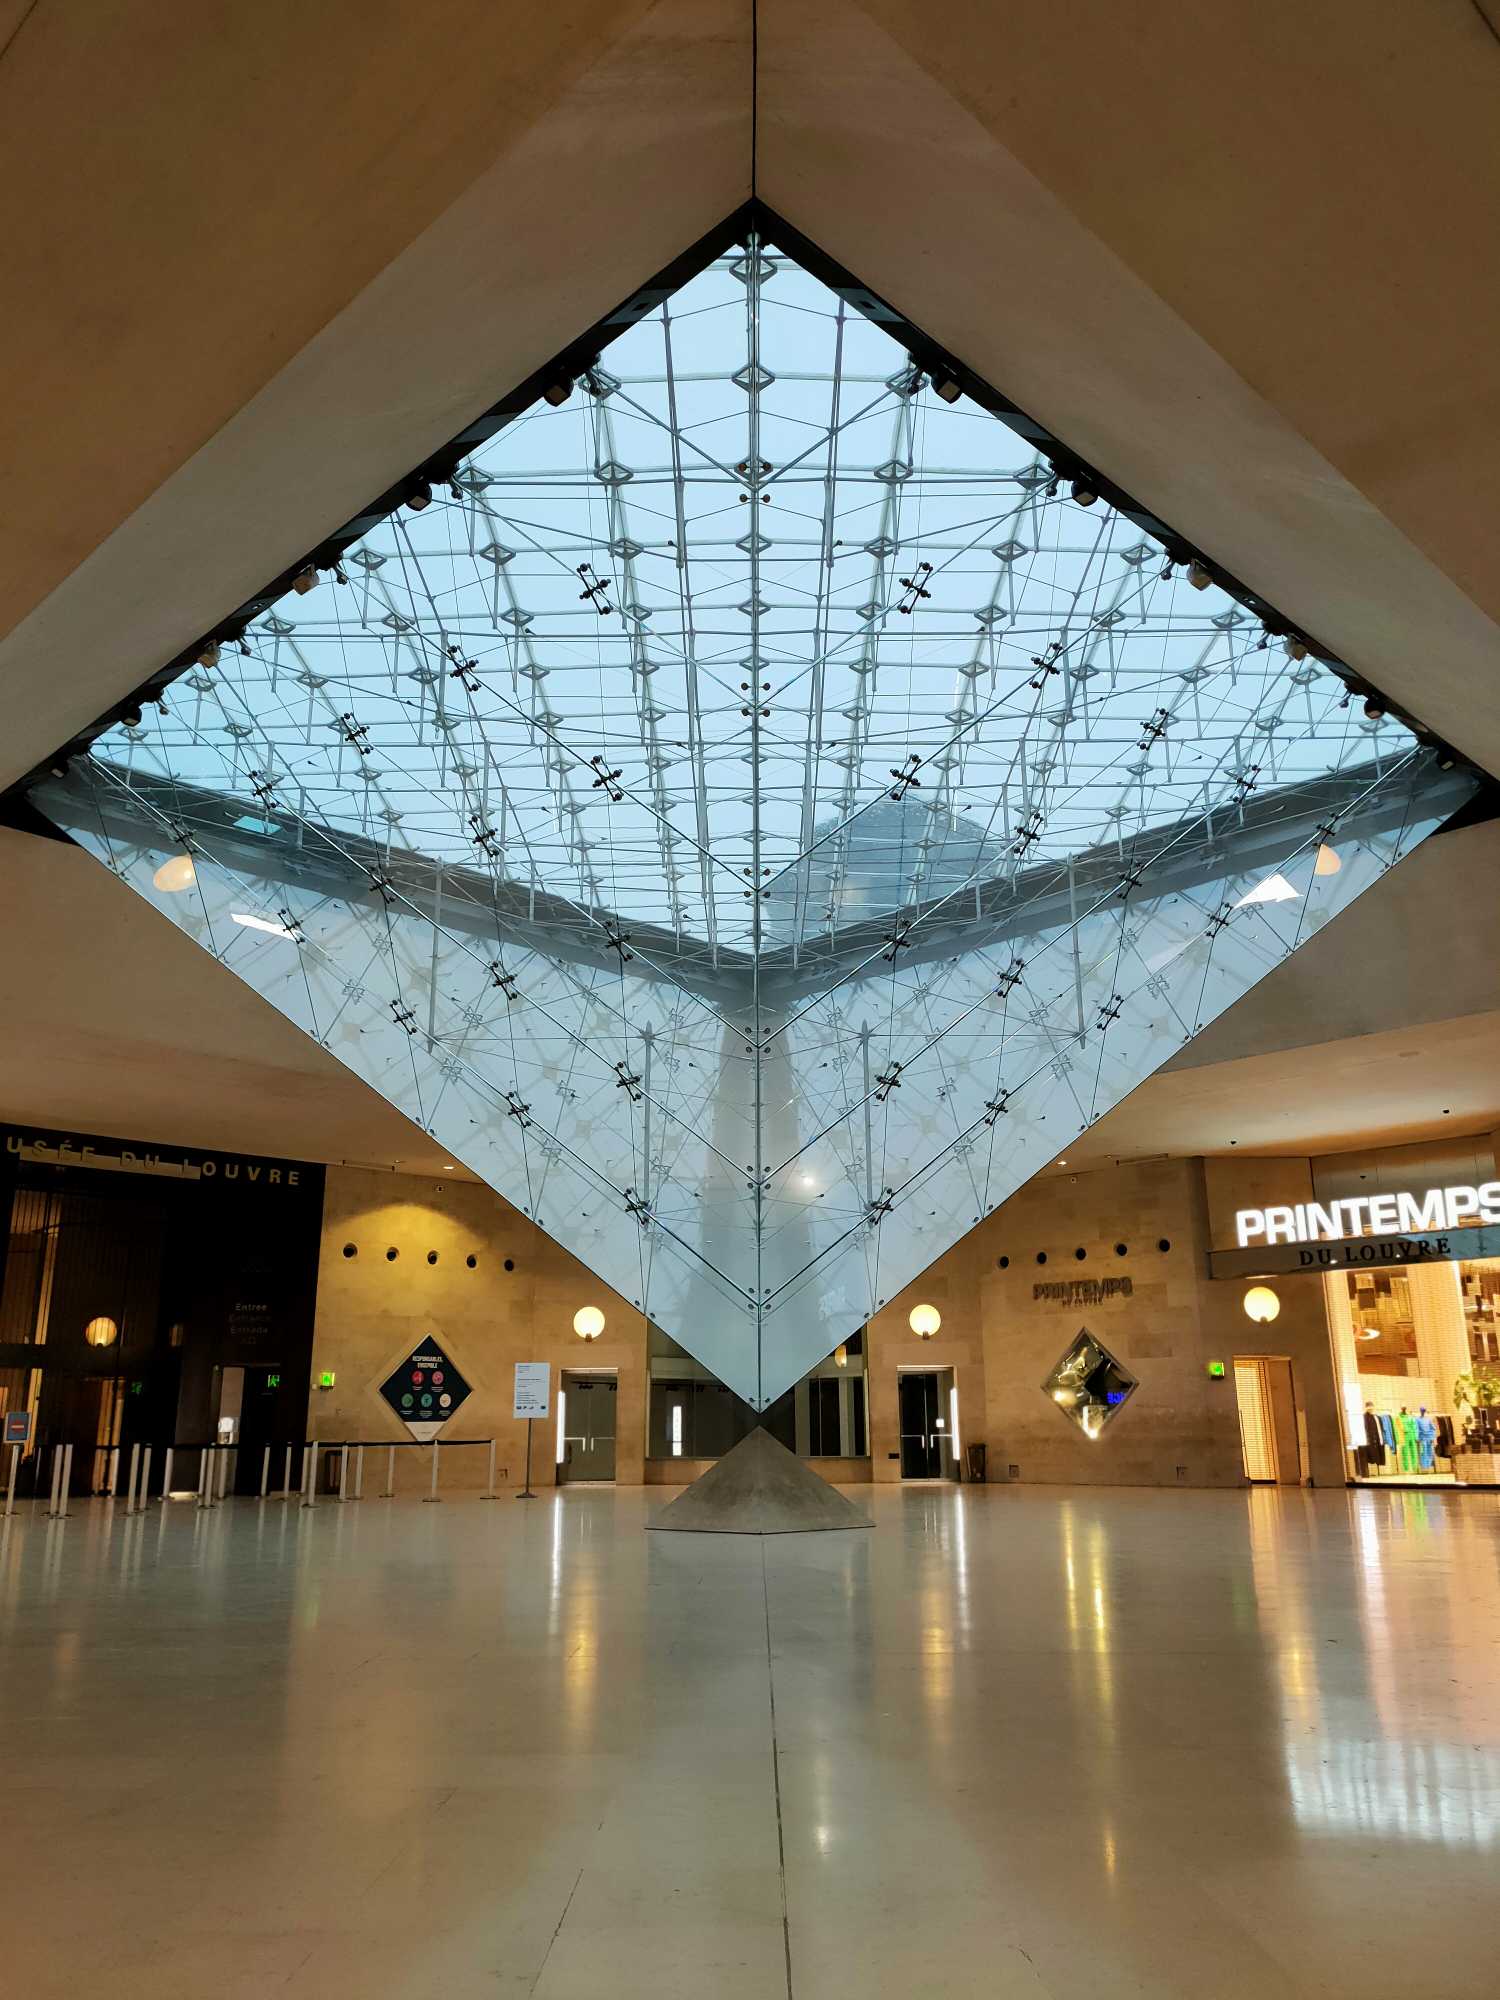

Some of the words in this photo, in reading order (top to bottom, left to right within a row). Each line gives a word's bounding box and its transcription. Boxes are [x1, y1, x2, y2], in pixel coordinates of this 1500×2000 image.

[120, 1151, 160, 1168] DU
[182, 1158, 300, 1186] LOUVRE
[1235, 1181, 1500, 1248] PRINTEMPS
[1300, 1250, 1332, 1267] DU
[1345, 1238, 1452, 1263] LOUVRE
